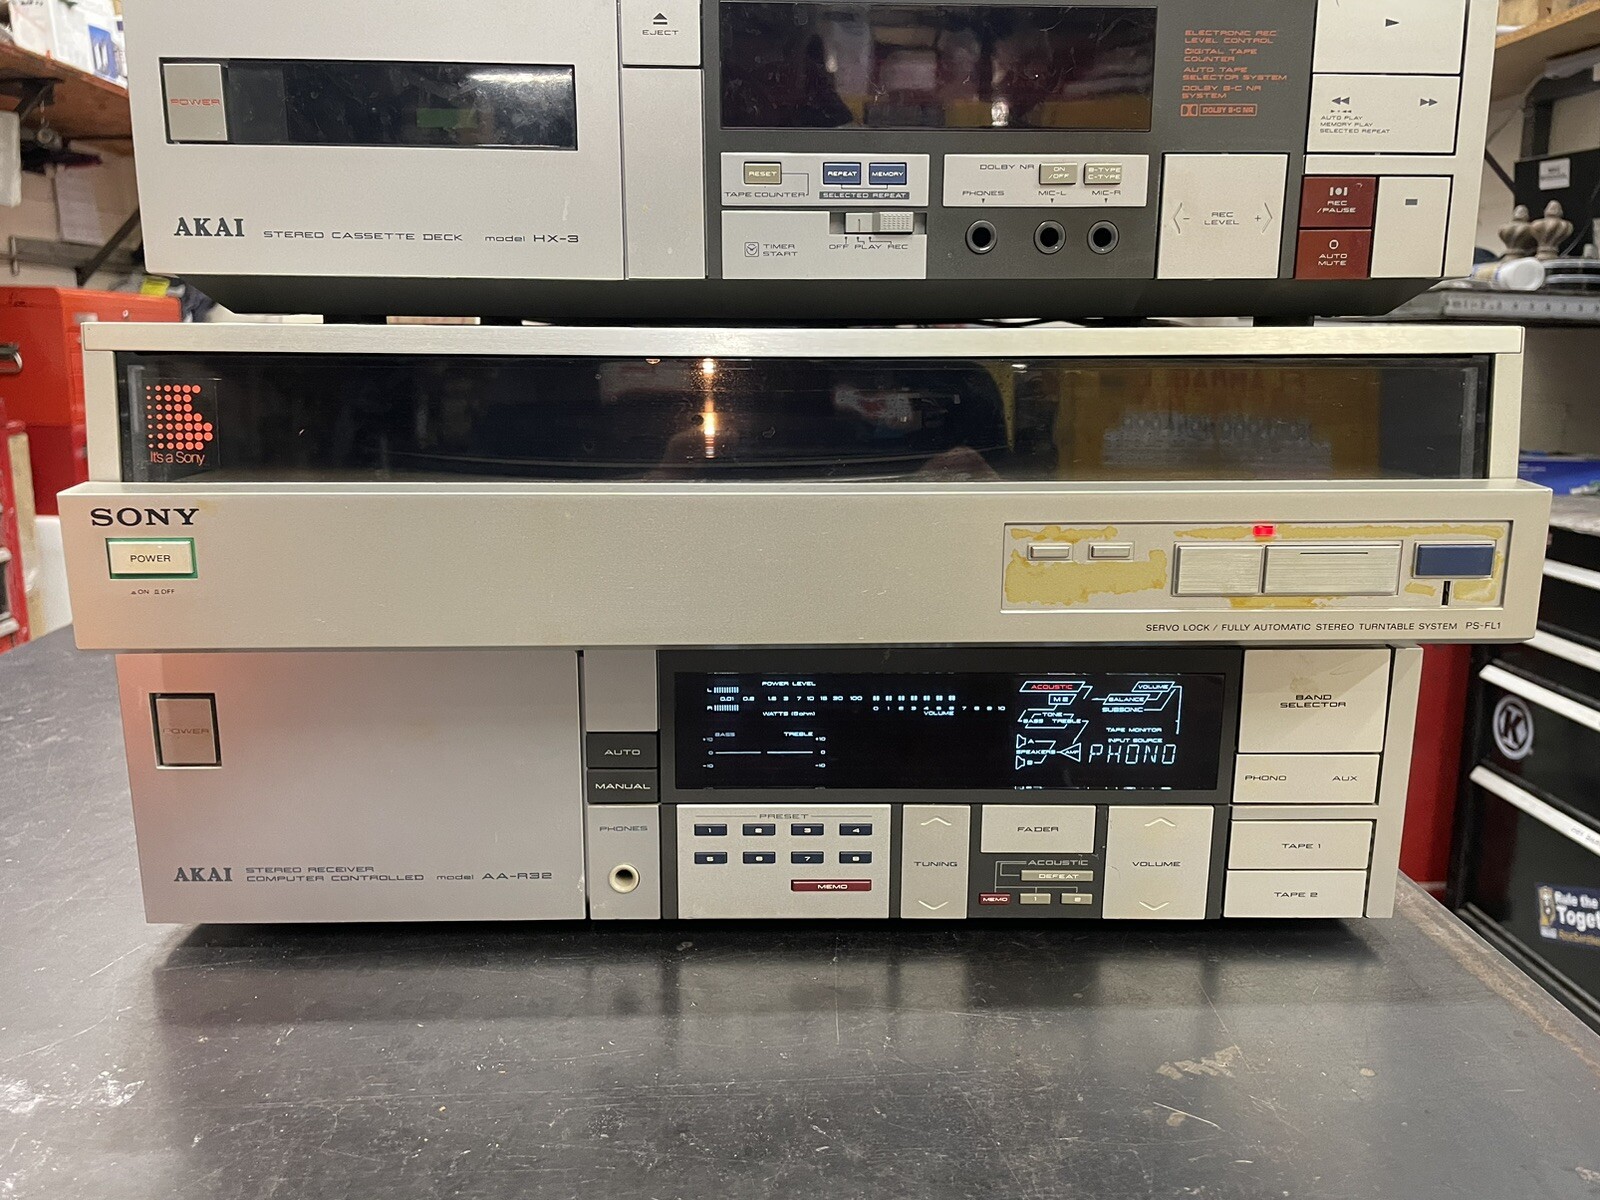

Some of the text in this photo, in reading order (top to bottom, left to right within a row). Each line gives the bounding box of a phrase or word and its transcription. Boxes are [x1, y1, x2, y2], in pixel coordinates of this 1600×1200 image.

[170, 98, 220, 106] POWER
[174, 217, 245, 237] AKAI
[264, 229, 579, 243] STEREO CASSETTE DECK model HX-3
[150, 451, 205, 466] It's a Sony
[90, 508, 200, 526] SONY
[1146, 624, 1179, 632] SERVO
[1253, 623, 1311, 631] AUTOMATIC
[1315, 623, 1355, 631] STEREO
[1359, 623, 1415, 631] TURNTABLE
[1418, 622, 1457, 630] SYSTEM
[1466, 622, 1501, 630] PS-FL1
[1089, 744, 1177, 764] PHONO
[173, 867, 233, 882] AKAI
